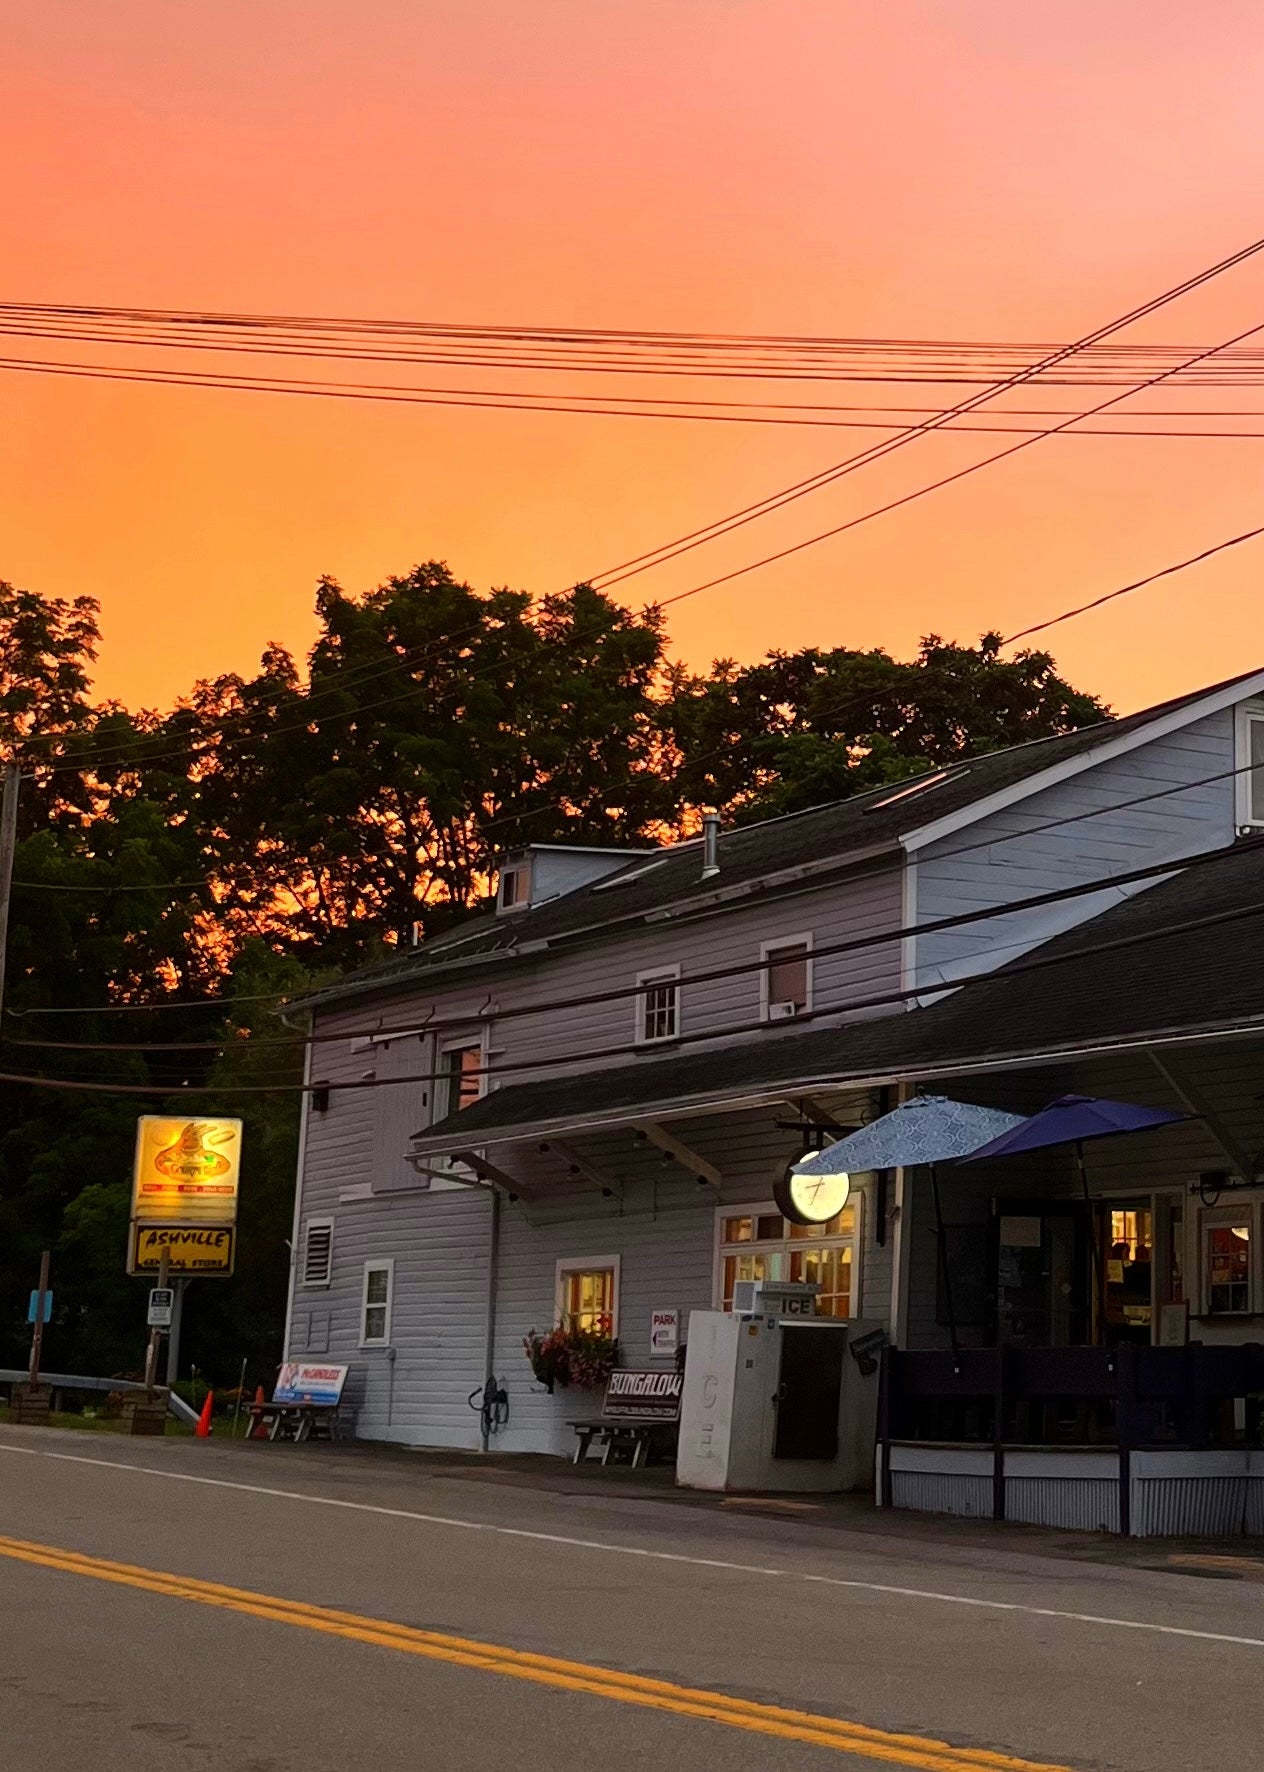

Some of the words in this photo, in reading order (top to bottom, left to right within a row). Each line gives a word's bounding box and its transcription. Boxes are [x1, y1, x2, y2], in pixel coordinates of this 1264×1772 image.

[145, 1230, 226, 1249] ASHVILLE
[781, 1299, 811, 1314] ICE
[653, 1314, 677, 1326] PARK
[608, 1373, 682, 1397] BUNGALOW
